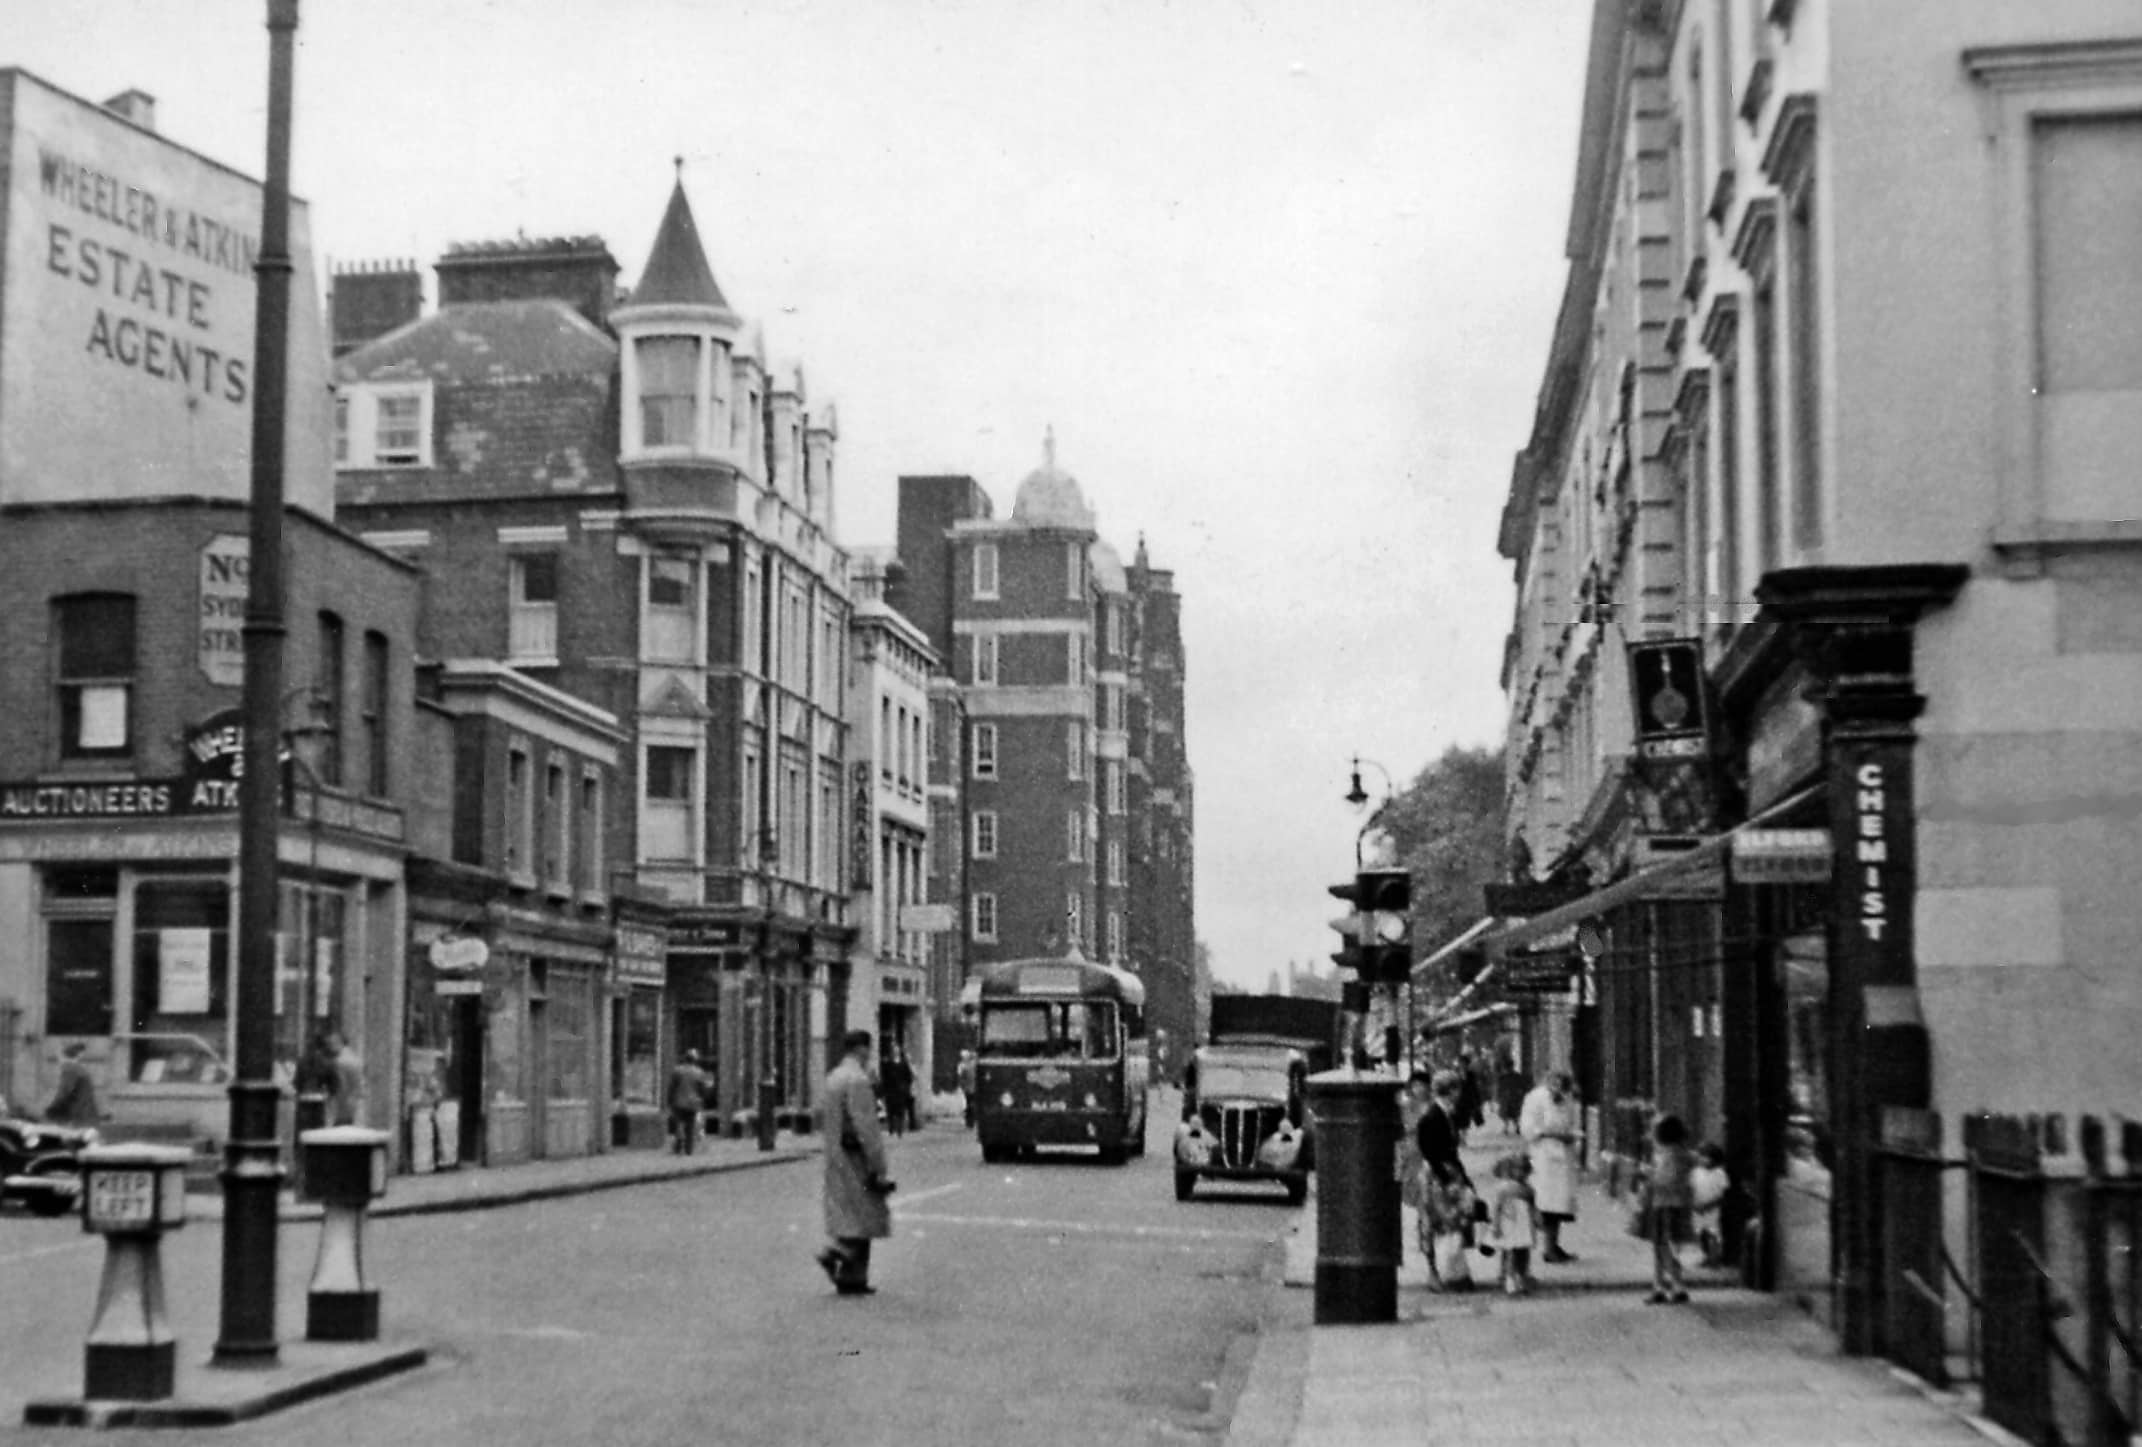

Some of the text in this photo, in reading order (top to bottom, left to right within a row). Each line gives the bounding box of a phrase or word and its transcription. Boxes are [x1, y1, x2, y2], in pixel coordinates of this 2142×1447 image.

[39, 149, 259, 281] WHEELER & ATKIN
[48, 221, 210, 331] ESTATE
[86, 307, 247, 404] AGENTS
[2, 785, 171, 814] AUCTIONEERS
[1856, 763, 1888, 941] CHEMIST
